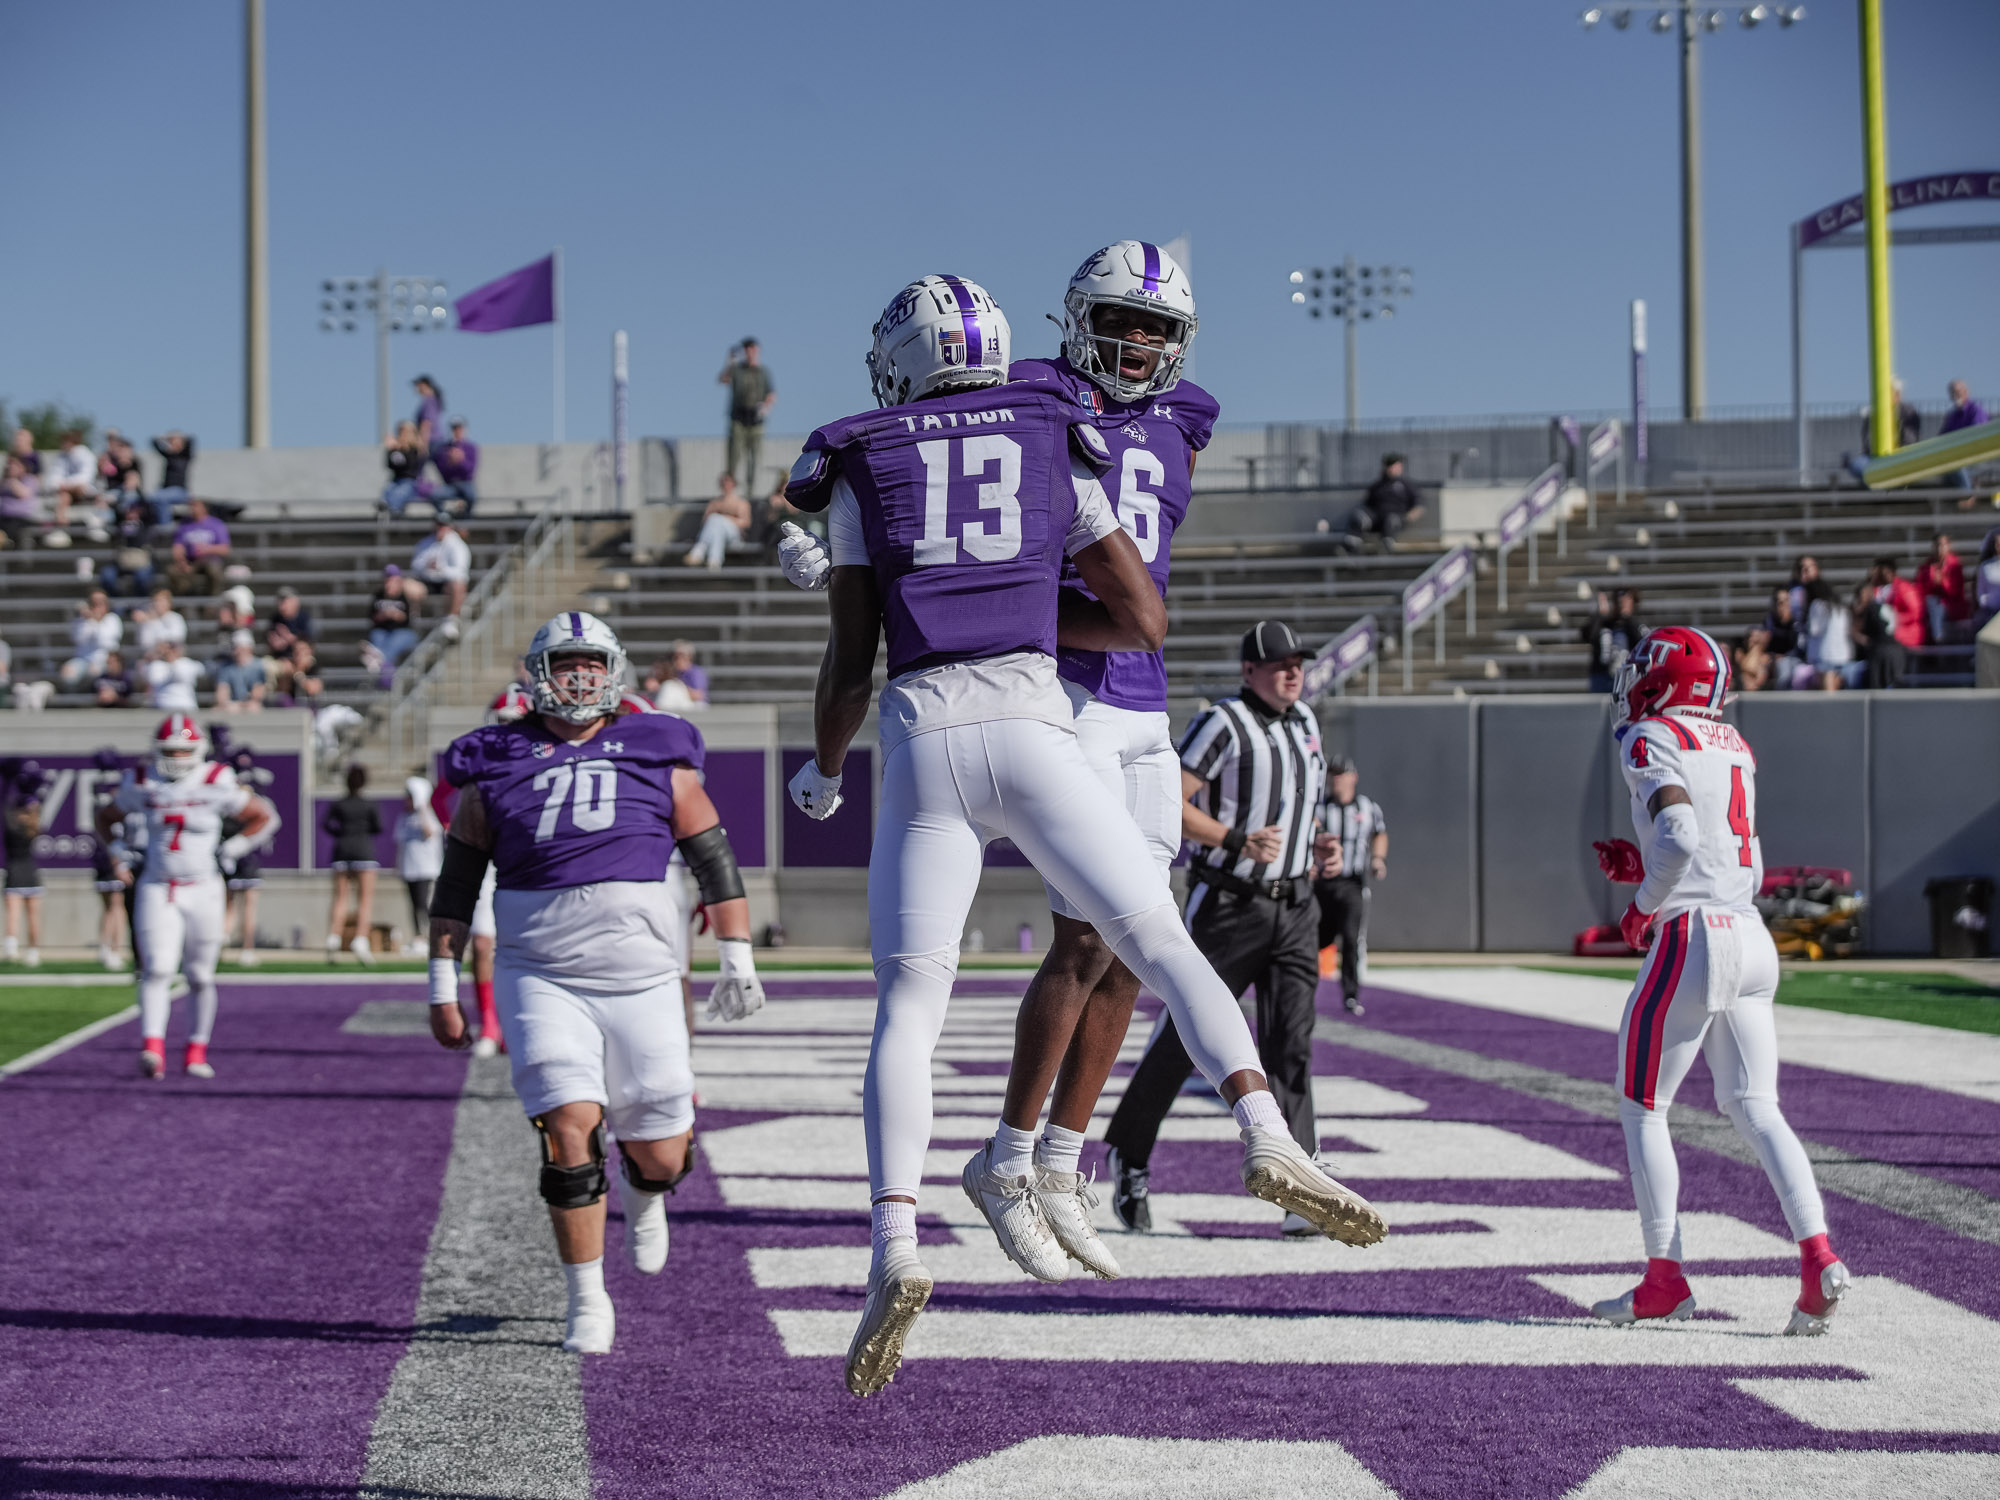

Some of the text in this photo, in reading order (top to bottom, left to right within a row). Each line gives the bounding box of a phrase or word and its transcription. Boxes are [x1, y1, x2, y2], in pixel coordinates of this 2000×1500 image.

[1816, 176, 1972, 232] CALINA
[988, 337, 999, 351] 13
[937, 369, 968, 380] ABILENE
[898, 408, 1016, 433] TAYLOR
[912, 434, 1023, 566] 13
[1117, 447, 1165, 564] 6
[1630, 736, 1649, 769] 4
[1697, 724, 1749, 753] SHERID
[532, 759, 618, 844] 70
[1727, 765, 1753, 868] 4
[164, 814, 185, 851] 7
